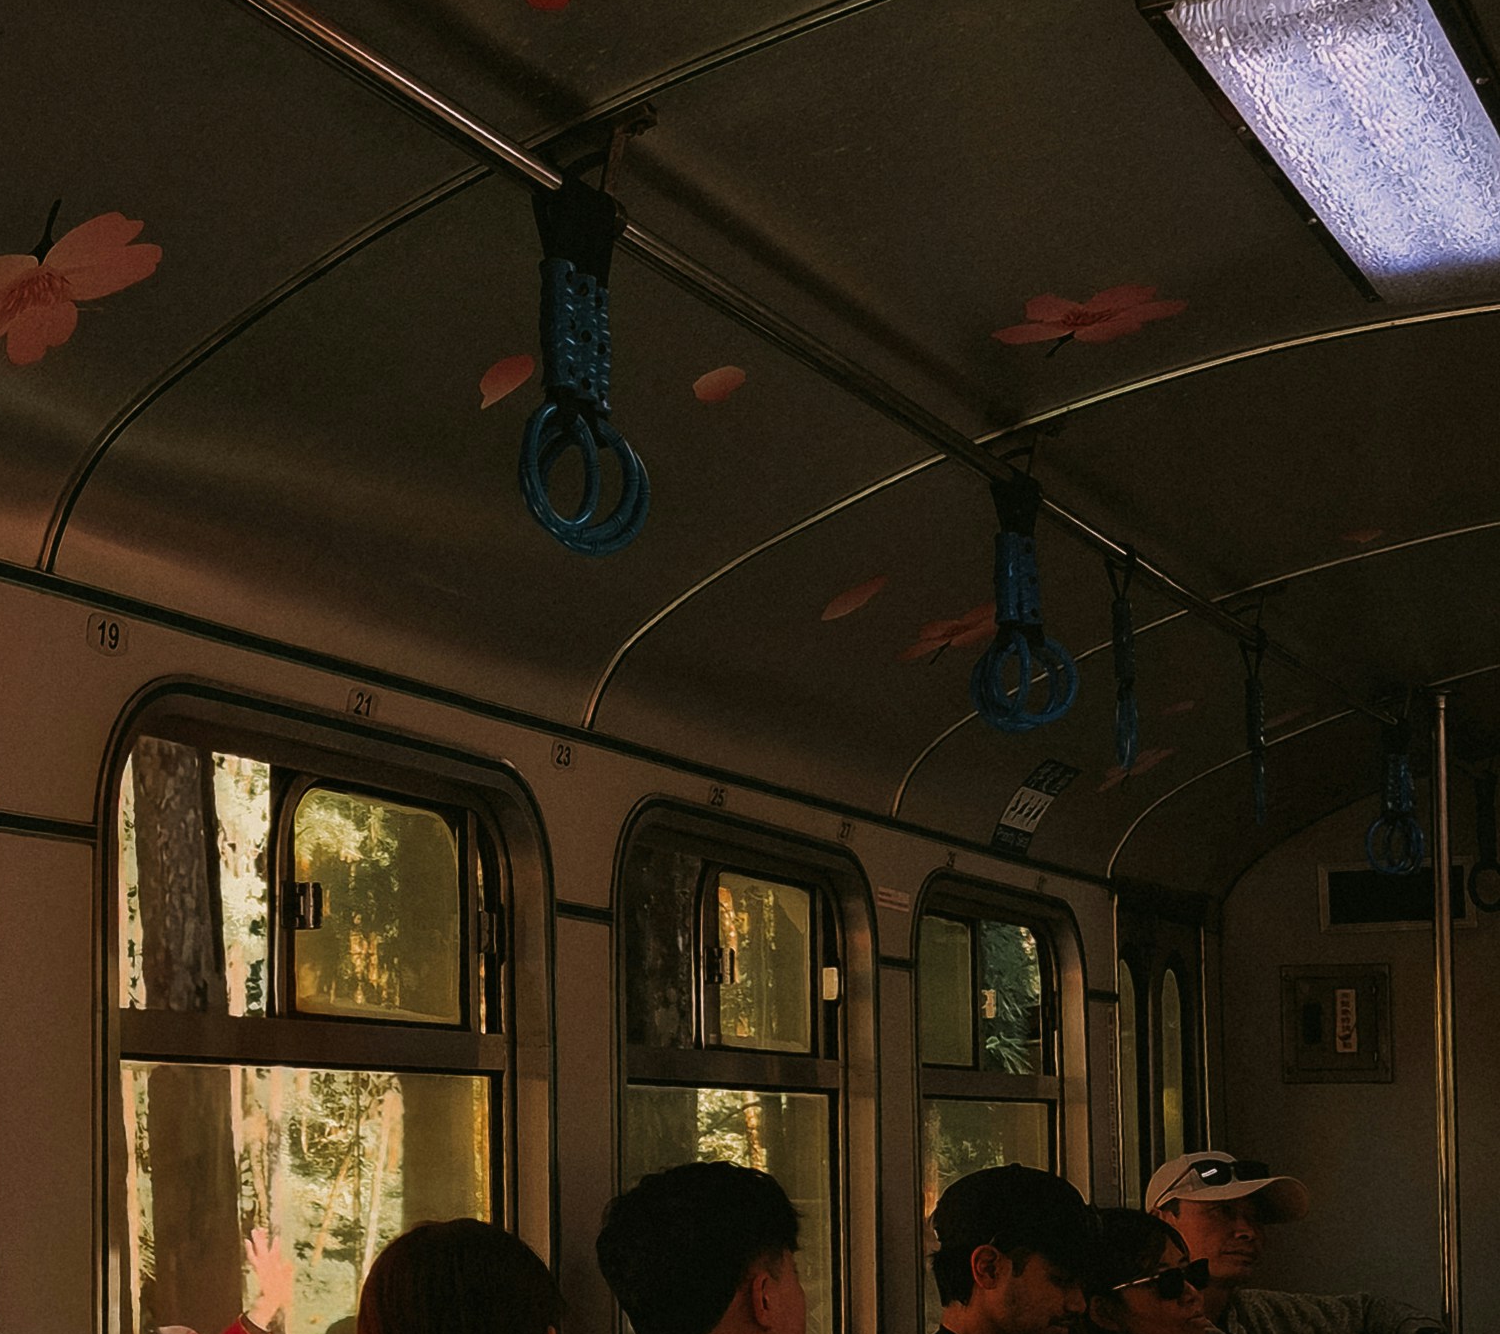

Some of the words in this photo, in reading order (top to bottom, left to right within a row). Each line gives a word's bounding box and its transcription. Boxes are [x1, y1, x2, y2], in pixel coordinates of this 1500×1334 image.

[97, 620, 119, 650] 19
[353, 691, 373, 717] 21
[555, 744, 572, 767] 23
[710, 787, 725, 807] 25
[839, 821, 851, 839] 27
